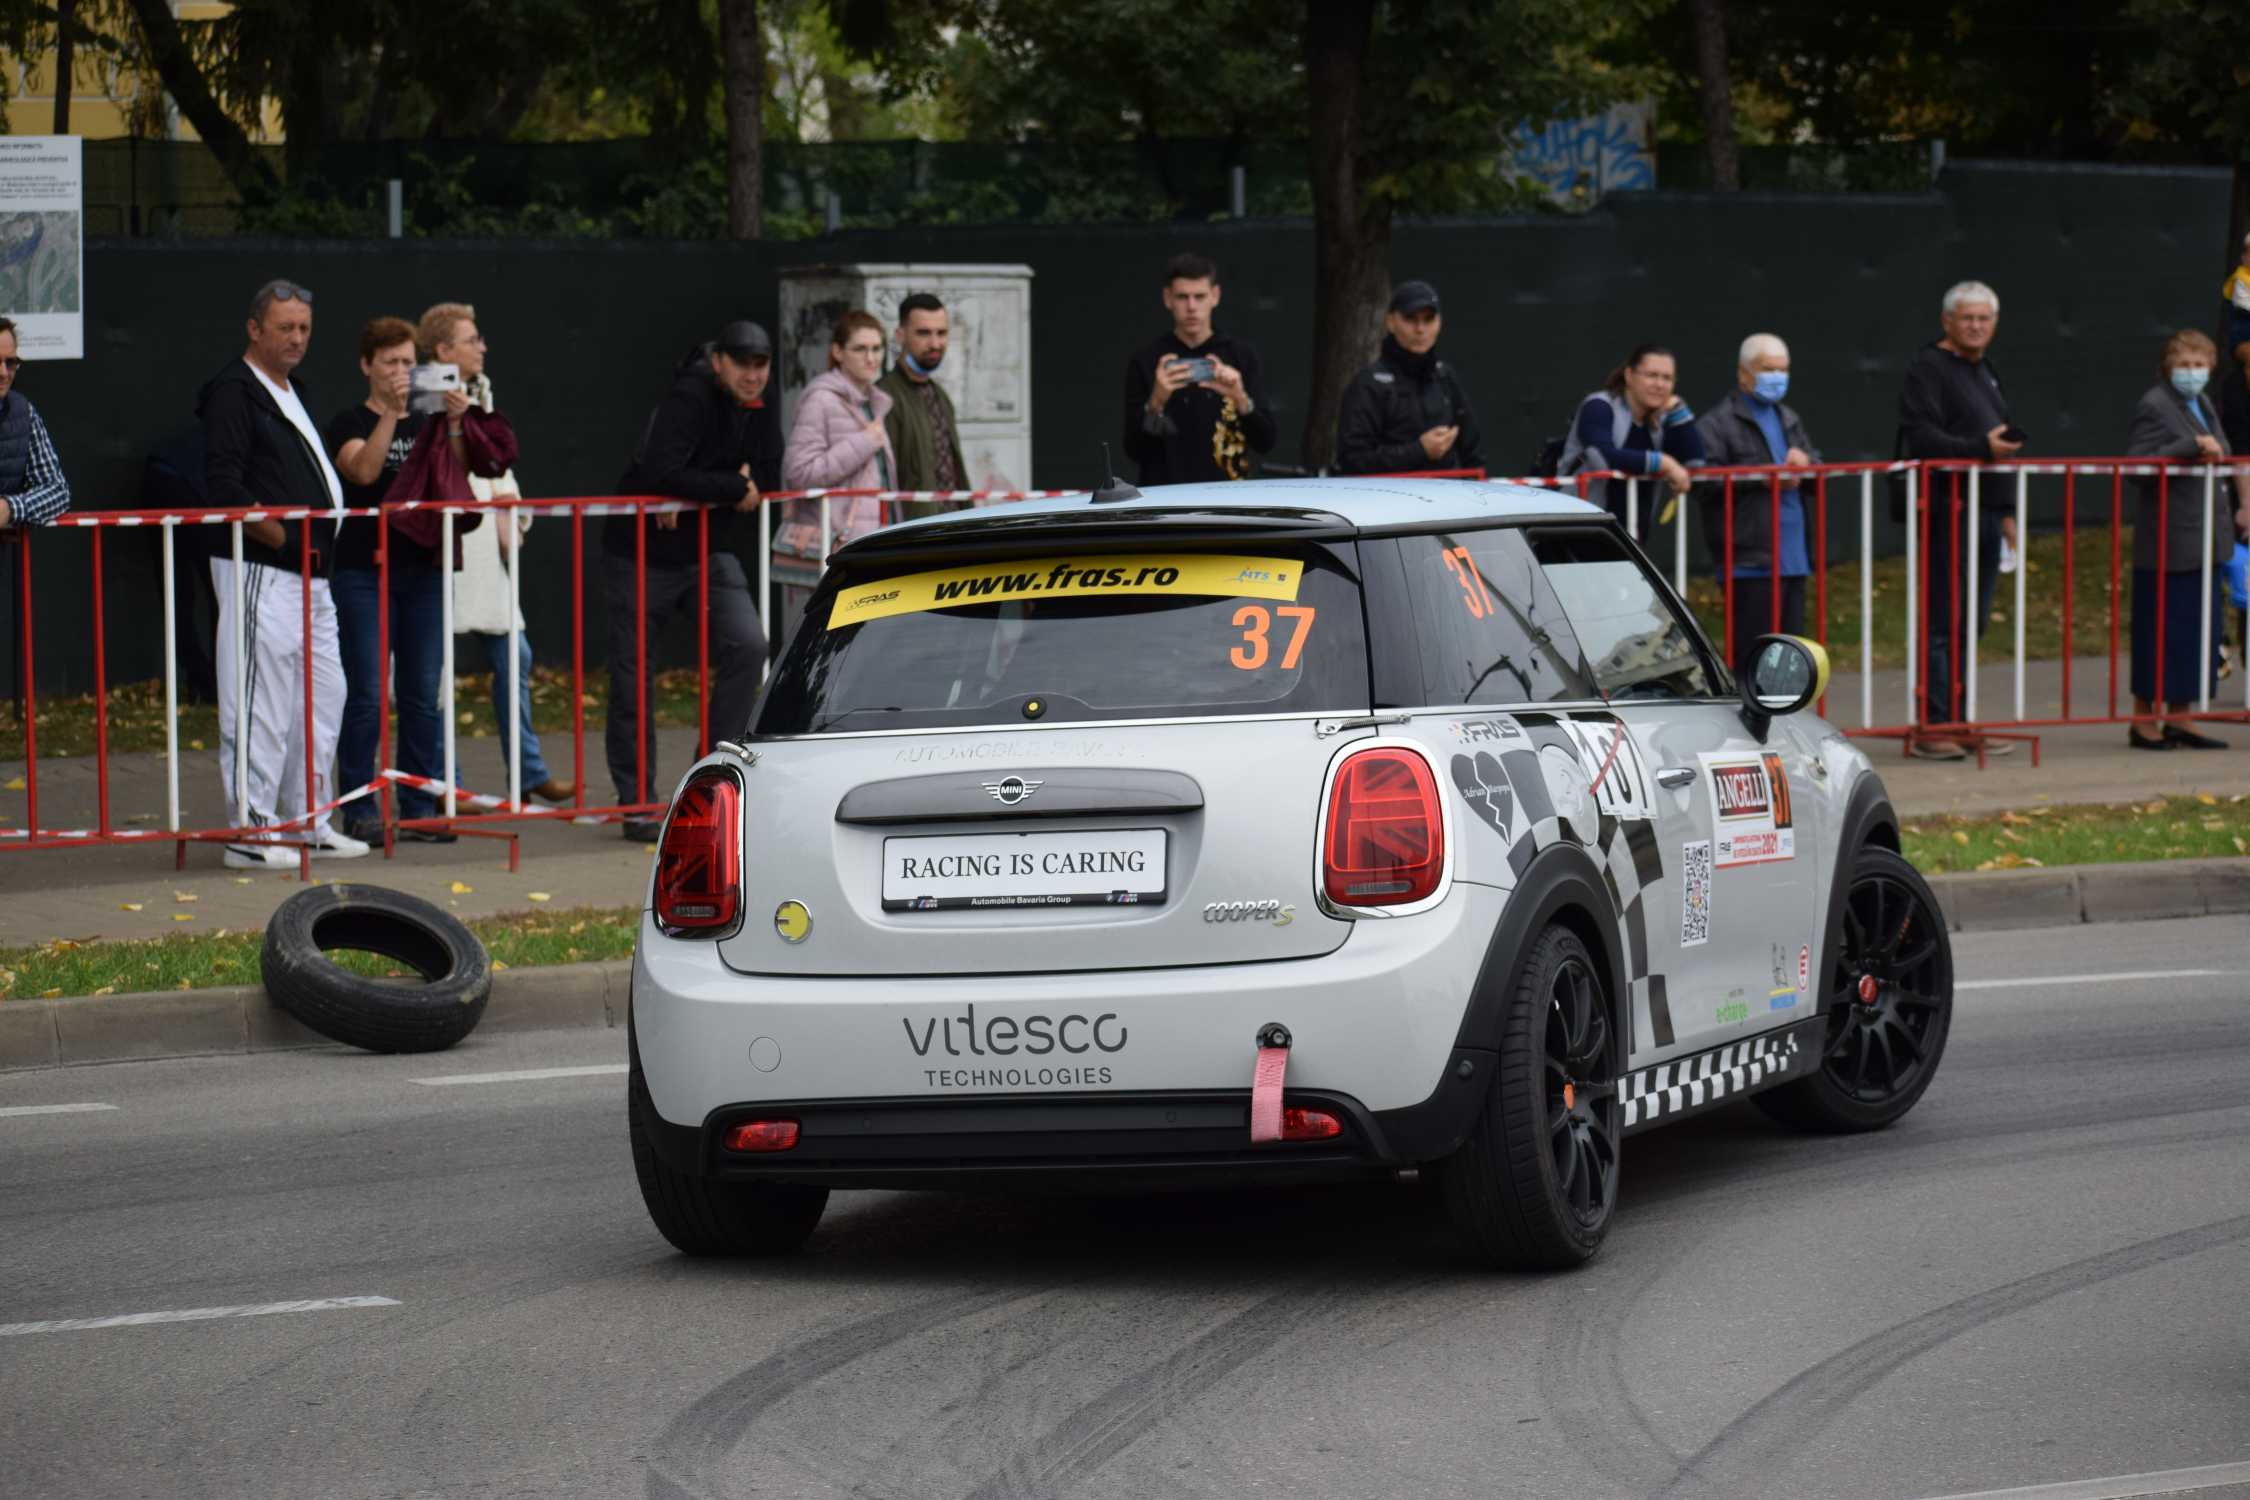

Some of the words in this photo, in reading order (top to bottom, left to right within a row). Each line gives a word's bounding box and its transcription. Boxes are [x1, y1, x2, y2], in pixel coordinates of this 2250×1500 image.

[934, 563, 1179, 601] www.fras.ro
[1442, 547, 1494, 619] 37
[1231, 605, 1316, 669] 37
[1461, 720, 1521, 743] FRAS
[1001, 785, 1023, 795] MINI
[1716, 773, 1767, 809] ANGELLI
[901, 854, 1001, 879] RACING
[1009, 853, 1035, 876] IS
[1042, 849, 1145, 875] CARING
[971, 897, 1015, 906] Automobile
[1016, 895, 1046, 904] Bavaria
[1048, 894, 1071, 904] Group
[1203, 899, 1279, 923] COOPER
[1272, 904, 1296, 926] S
[903, 1003, 1127, 1056] vitesco
[924, 1067, 1113, 1087] TECHNOLOGIES
